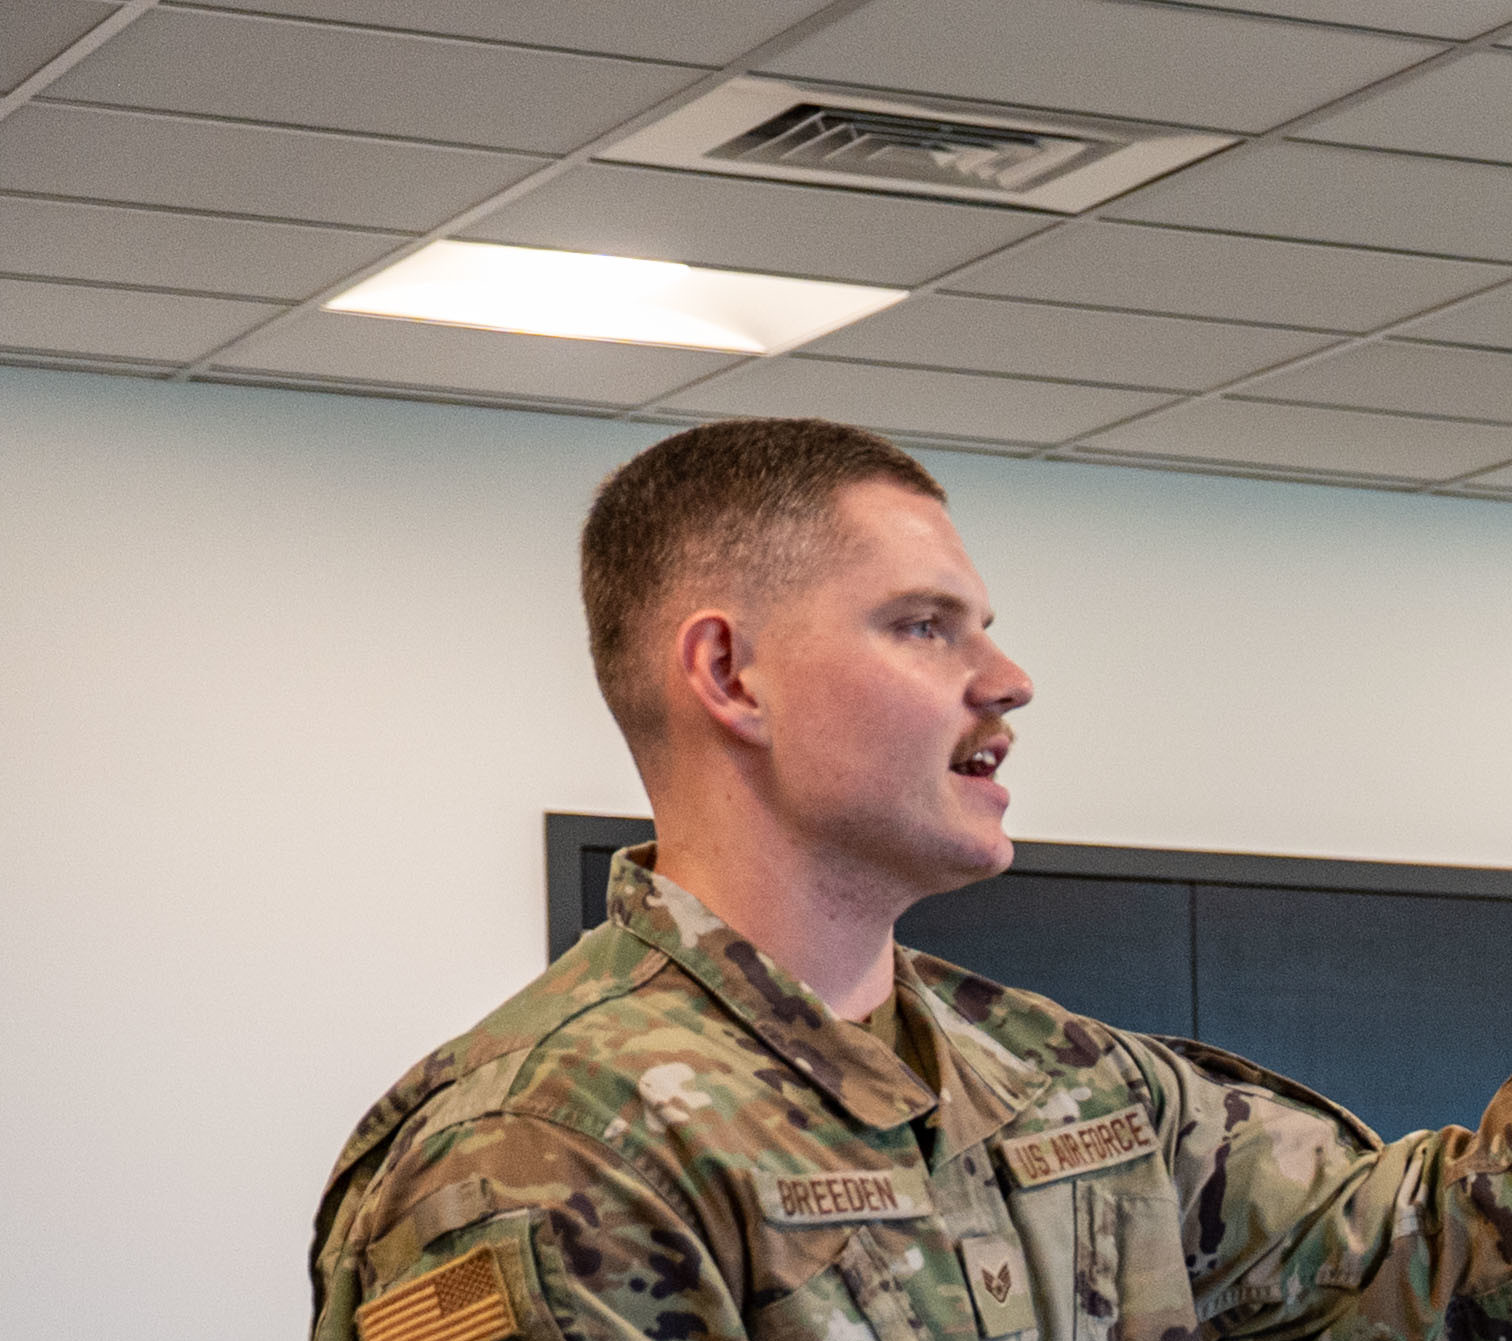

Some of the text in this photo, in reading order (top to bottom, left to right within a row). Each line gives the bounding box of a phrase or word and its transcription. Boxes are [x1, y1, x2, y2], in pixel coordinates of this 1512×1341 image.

[1051, 1132, 1085, 1171] AIR
[1078, 1111, 1149, 1163] FORCE
[776, 1176, 899, 1217] BREEDEN
